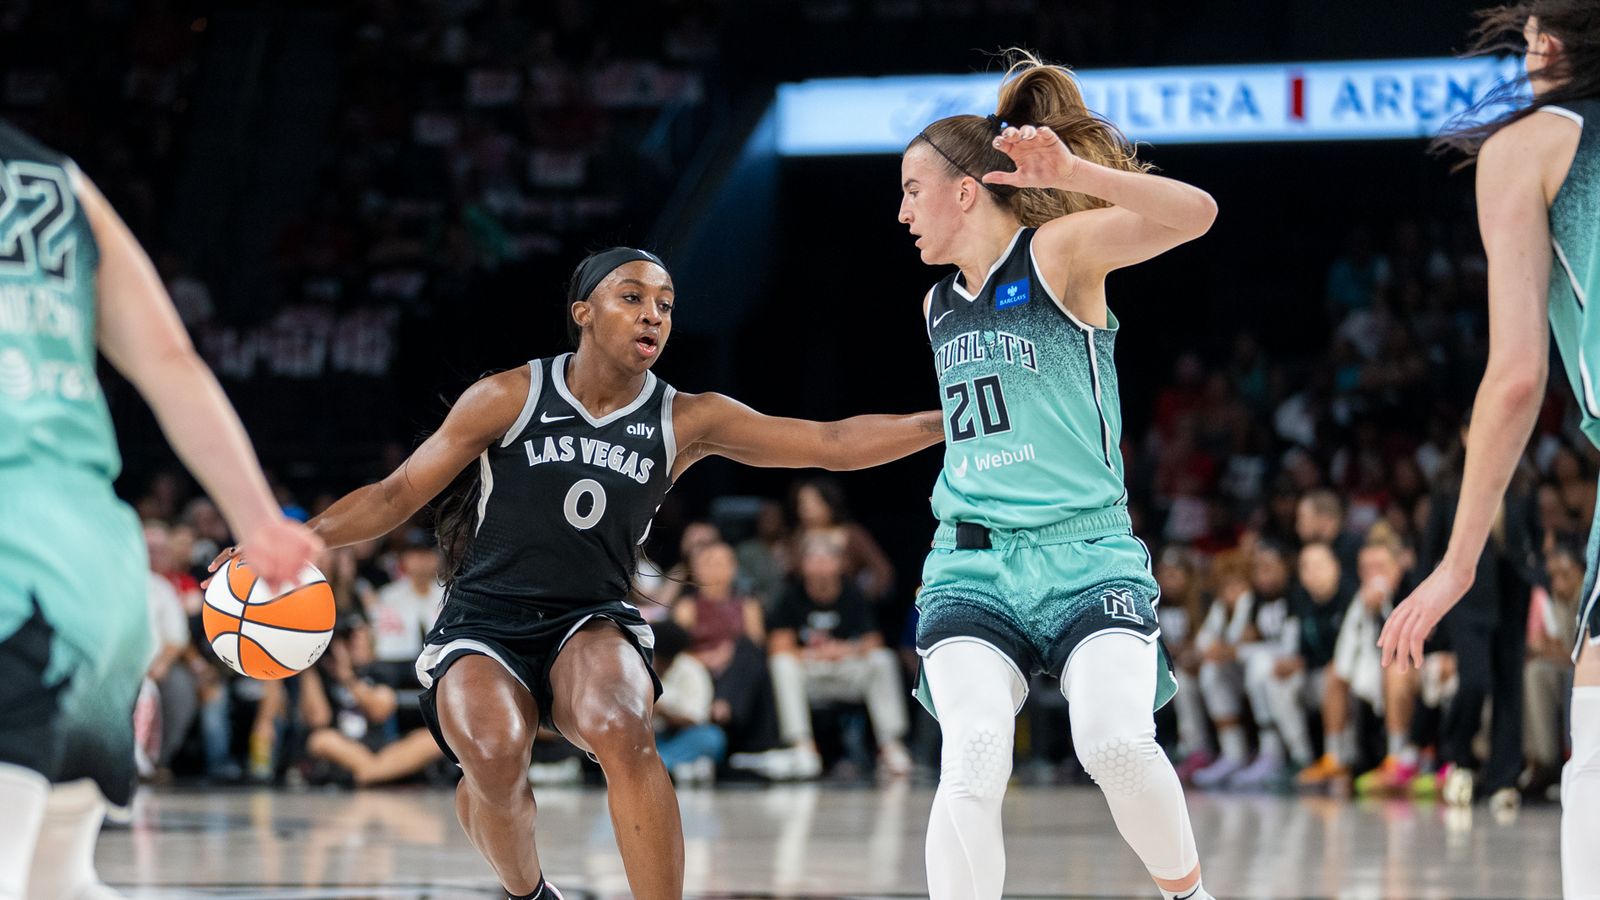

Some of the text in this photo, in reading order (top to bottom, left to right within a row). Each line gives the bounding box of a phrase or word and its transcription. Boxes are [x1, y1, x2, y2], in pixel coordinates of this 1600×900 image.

[1000, 293, 1027, 306] BARCLAYS
[946, 374, 1012, 444] 20
[626, 423, 655, 438] ally
[524, 436, 654, 484] LAS VEGAS
[975, 443, 1035, 471] Webull
[564, 479, 606, 529] 0
